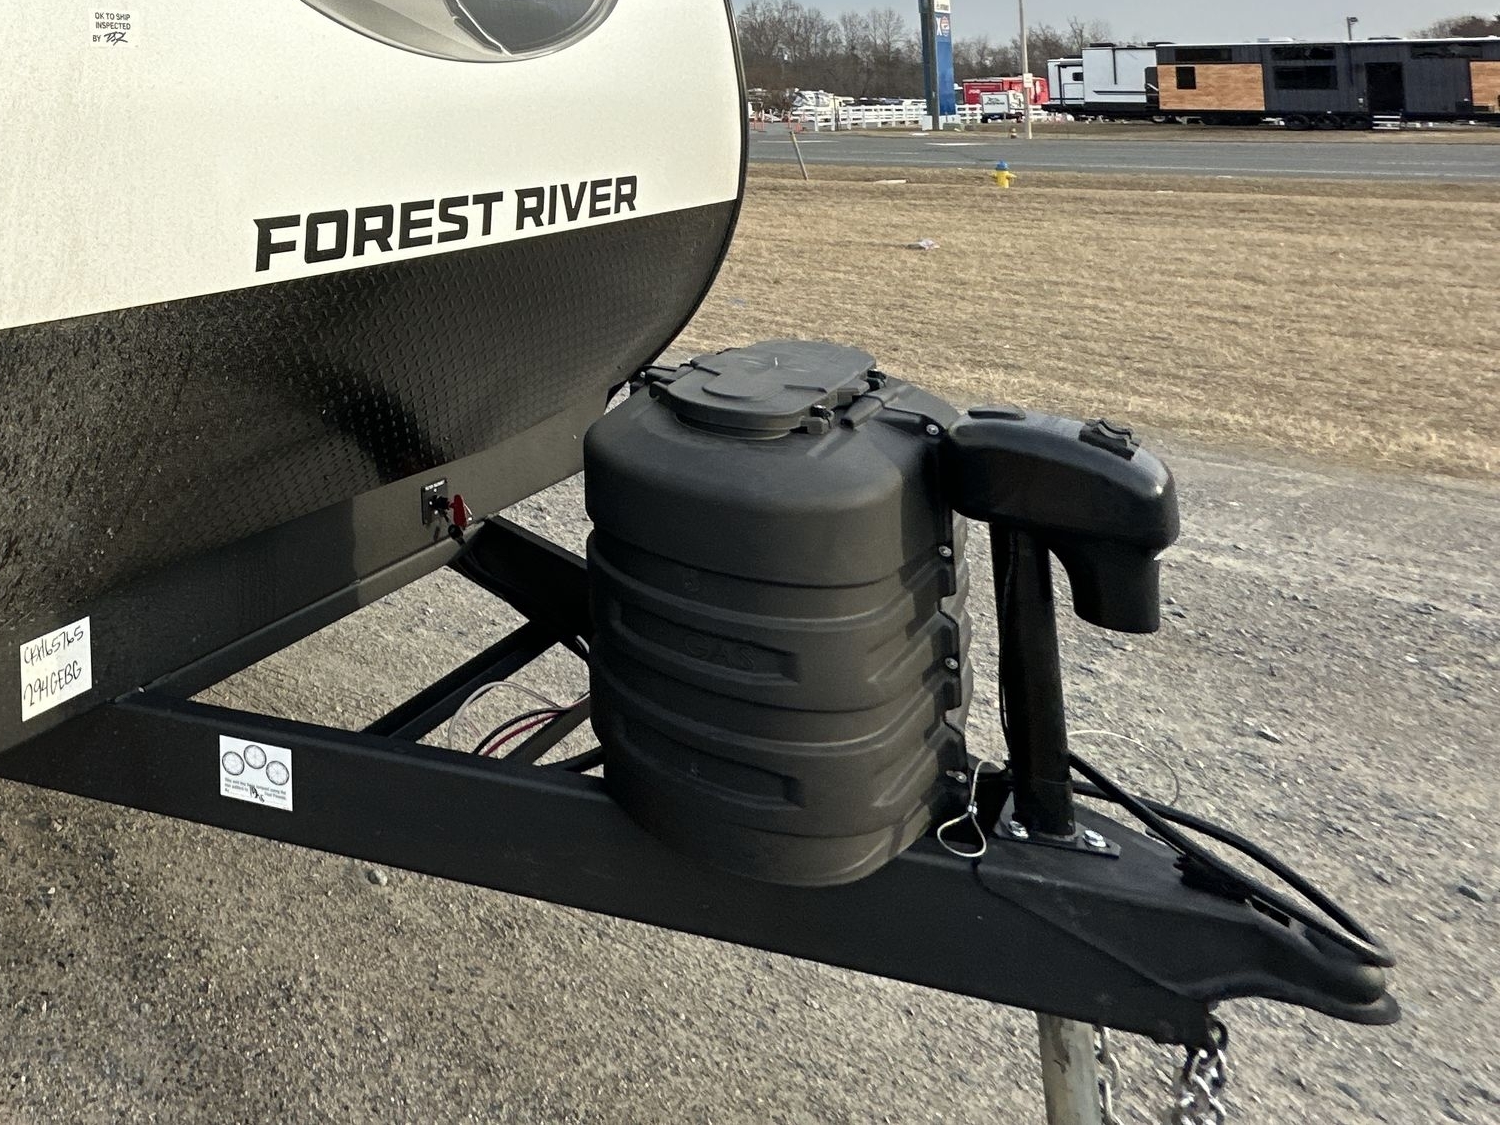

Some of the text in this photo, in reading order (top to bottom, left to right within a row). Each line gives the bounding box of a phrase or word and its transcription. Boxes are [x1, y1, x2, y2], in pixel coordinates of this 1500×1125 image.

[94, 11, 131, 21] OK TO SHIP
[95, 21, 131, 30] INSPECTED
[253, 175, 638, 273] FOREST RIVER
